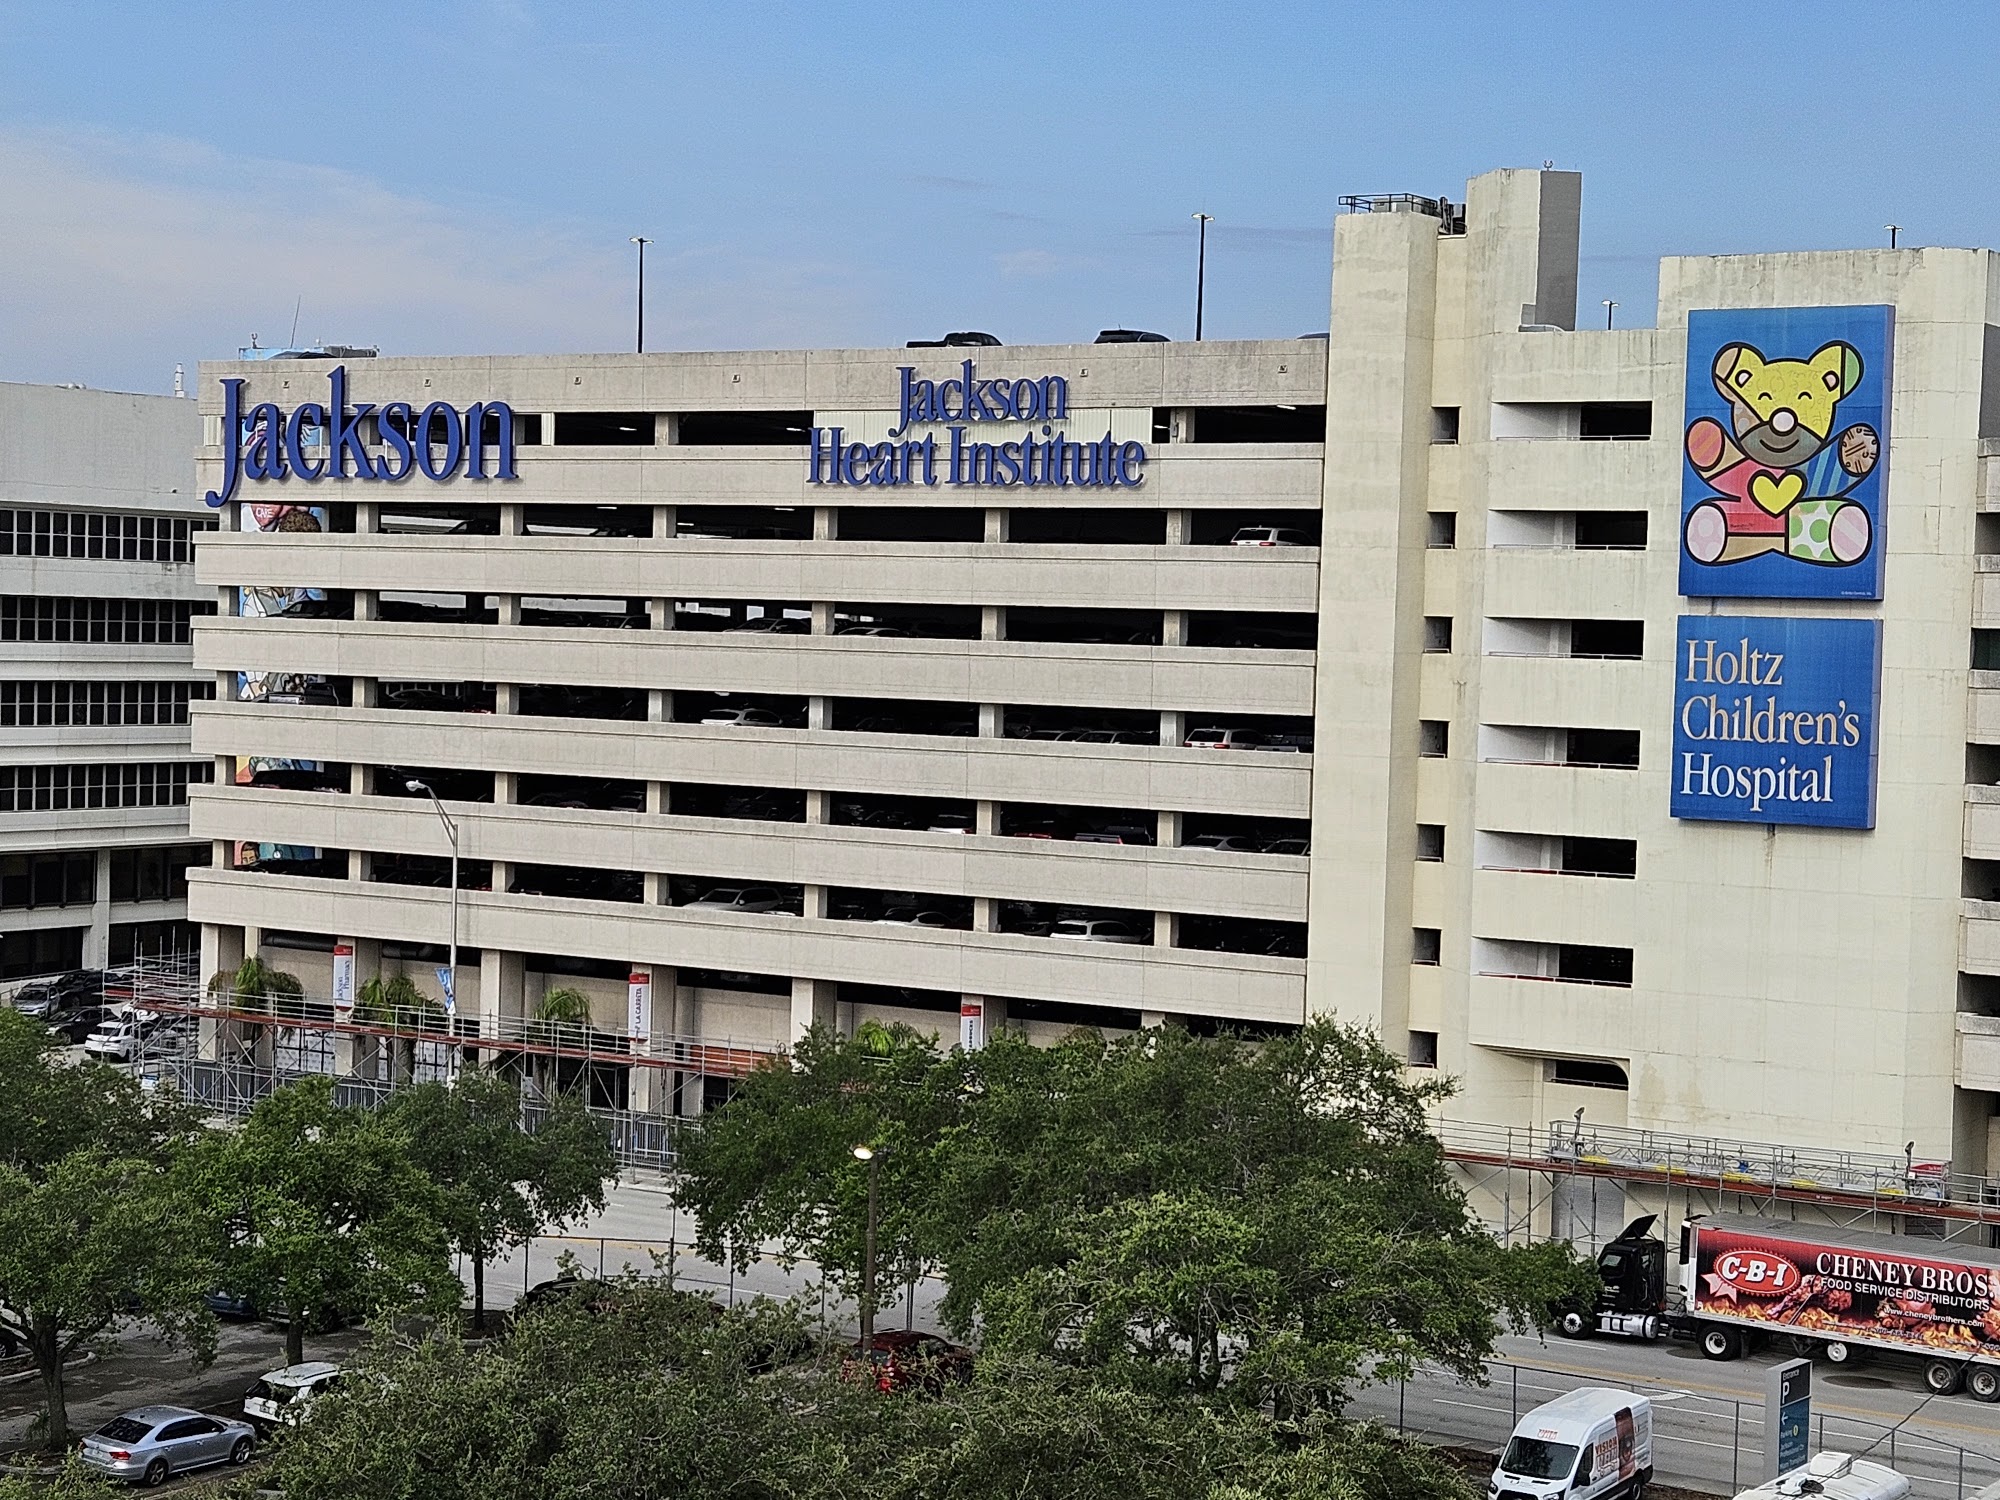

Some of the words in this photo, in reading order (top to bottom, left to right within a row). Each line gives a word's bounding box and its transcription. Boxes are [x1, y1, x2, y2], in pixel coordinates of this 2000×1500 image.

[888, 359, 1069, 437] Jackson
[205, 365, 519, 508] Jackson
[805, 426, 938, 487] Heart
[944, 424, 1145, 487] Institute
[1684, 637, 1784, 686] Holtz
[1681, 693, 1861, 747] Children's
[1679, 751, 1834, 812] Hospital
[1721, 1256, 1788, 1287] C-B-I
[1816, 1252, 1920, 1286] CHENEY
[1921, 1266, 1995, 1298] BROS.
[1820, 1278, 1852, 1291] FOOD
[1854, 1283, 1903, 1299] SERVICE
[1905, 1289, 1991, 1311] DISTRIBUTORS
[1884, 1307, 1985, 1328] www.cheneybrothers.com
[1782, 1381, 1790, 1405] P
[1595, 1436, 1618, 1455] VISION
